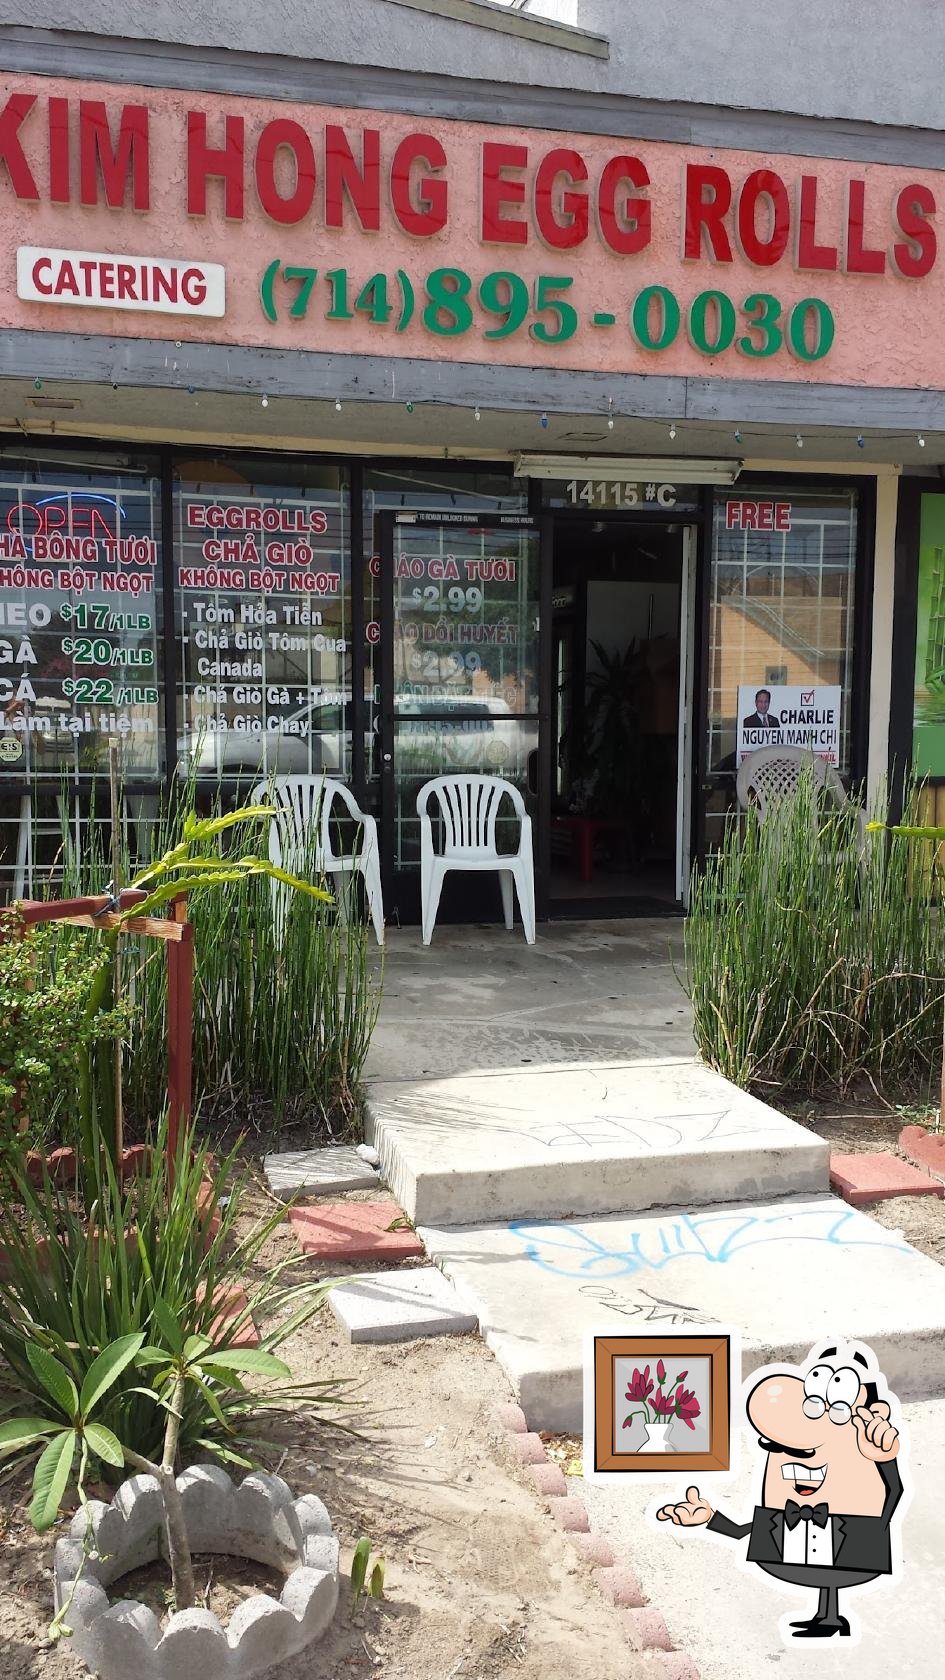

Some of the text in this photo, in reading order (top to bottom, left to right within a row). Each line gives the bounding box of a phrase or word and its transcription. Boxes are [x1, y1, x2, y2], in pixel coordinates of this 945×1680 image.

[0, 93, 937, 278] KIM HONG EGG ROLLS
[32, 257, 207, 306] CATERING
[566, 481, 677, 507] 14115 #C
[7, 504, 119, 540] OPEN
[187, 504, 328, 533] EGGROLLS
[726, 502, 791, 531] FREE
[32, 530, 98, 562] BÔNG
[104, 535, 157, 565] TƯƠI
[203, 533, 314, 566] CHẢ GIÒ
[179, 564, 340, 597] KHÔNG BỘT NGỌT
[369, 552, 516, 582] CÁO GÀ TƯƠI
[59, 566, 98, 595] BỘT
[101, 572, 154, 598] NGỌT
[193, 602, 235, 623] Tôm
[412, 585, 483, 613] $2.99
[0, 602, 51, 626] EO
[194, 629, 229, 649] Chả
[234, 631, 264, 650] Giò
[269, 632, 306, 651] Tôm
[197, 657, 263, 677] Canada
[193, 684, 228, 704] Chả
[232, 686, 262, 705] Giò
[266, 686, 290, 705] Gà
[0, 711, 51, 731] Làm
[58, 713, 91, 738] tại
[194, 711, 310, 737] Chả Giò Chay
[780, 709, 834, 725] CHARLIE
[742, 729, 837, 745] NGUYEN MANH CHI
